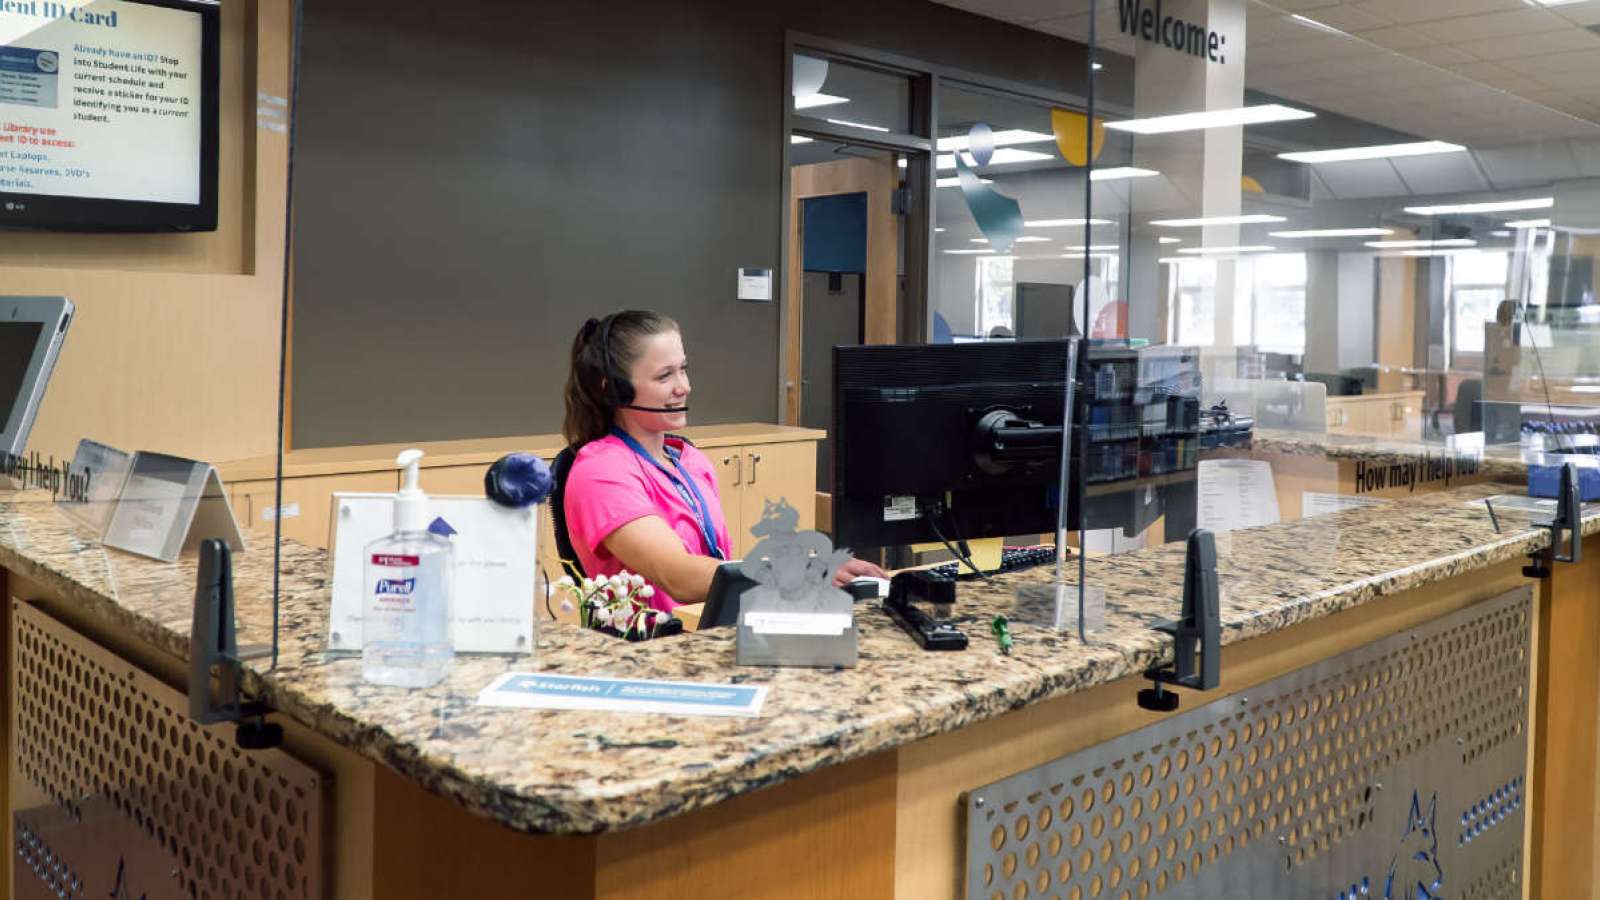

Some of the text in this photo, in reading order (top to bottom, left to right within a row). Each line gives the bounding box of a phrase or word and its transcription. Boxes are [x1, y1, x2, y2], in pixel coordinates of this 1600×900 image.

[44, 2, 65, 18] ID
[69, 7, 117, 27] Card
[1118, 0, 1226, 64] Welcome:
[73, 44, 107, 57] Already
[109, 48, 131, 58] have
[160, 55, 179, 66] Stop
[73, 57, 188, 80] into Student Life with your
[74, 73, 164, 89] current schedule and
[74, 87, 105, 96] receive
[114, 90, 143, 100] sticker
[159, 96, 179, 104] your
[180, 97, 189, 105] ID
[73, 99, 121, 113] identifying
[123, 105, 138, 113] you
[159, 109, 188, 118] current
[3, 122, 56, 136] Library use
[18, 136, 27, 144] ID
[30, 137, 38, 145] to
[65, 168, 90, 178] DVD's
[36, 451, 60, 503] help
[62, 459, 91, 503] You?
[1356, 461, 1387, 494] How
[1390, 462, 1417, 493] may
[1426, 449, 1453, 486] help
